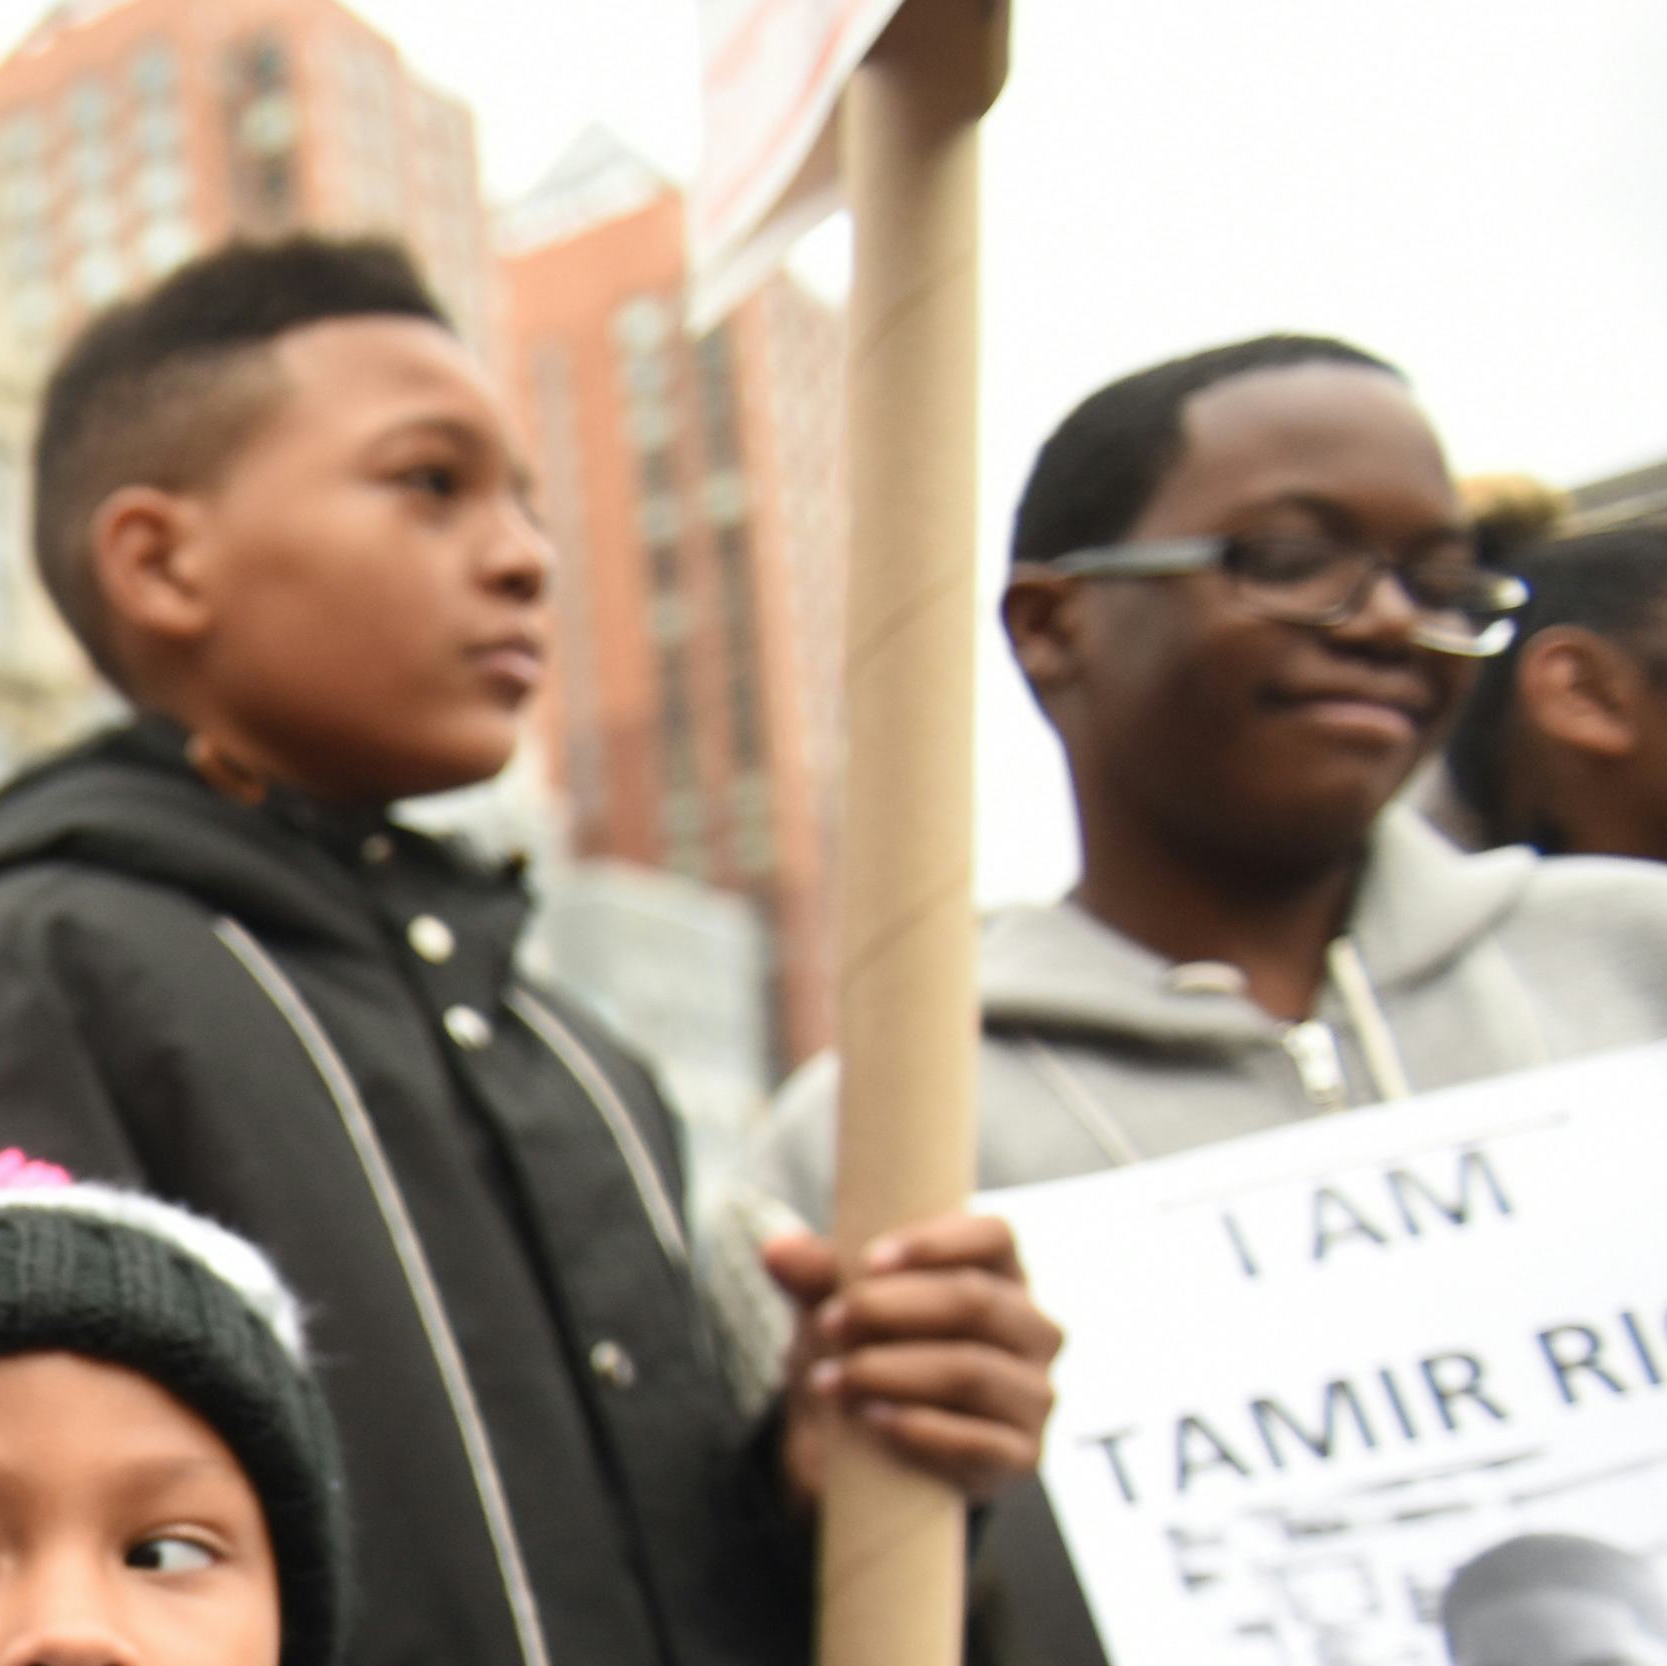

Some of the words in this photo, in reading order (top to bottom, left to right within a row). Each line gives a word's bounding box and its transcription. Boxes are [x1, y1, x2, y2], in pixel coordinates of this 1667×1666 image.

[1221, 1211, 1261, 1280] I
[1309, 1148, 1515, 1262] AM
[1079, 1348, 1512, 1507] TAMIR
[1534, 1308, 1667, 1408] RI
